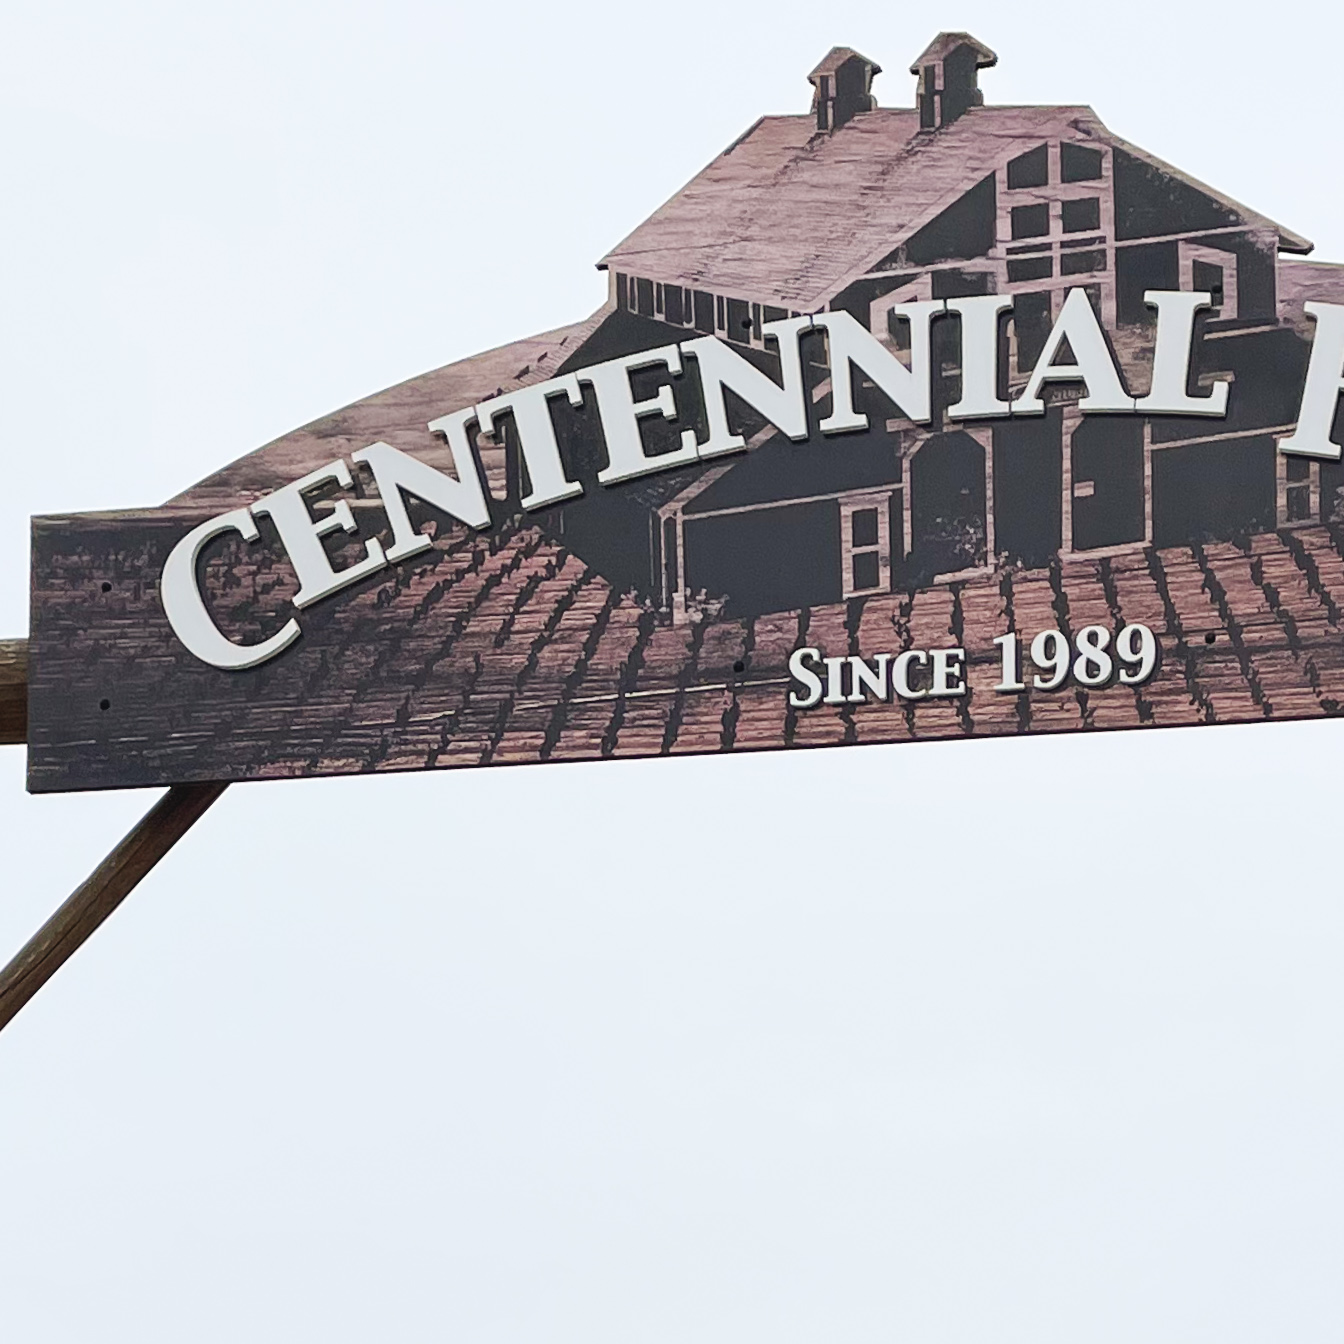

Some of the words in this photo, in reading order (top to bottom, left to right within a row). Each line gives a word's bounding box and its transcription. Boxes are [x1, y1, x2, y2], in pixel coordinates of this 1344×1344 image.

[160, 286, 1230, 672] CENTENNIAL
[787, 645, 967, 708] SINCE
[992, 623, 1159, 695] 1989
